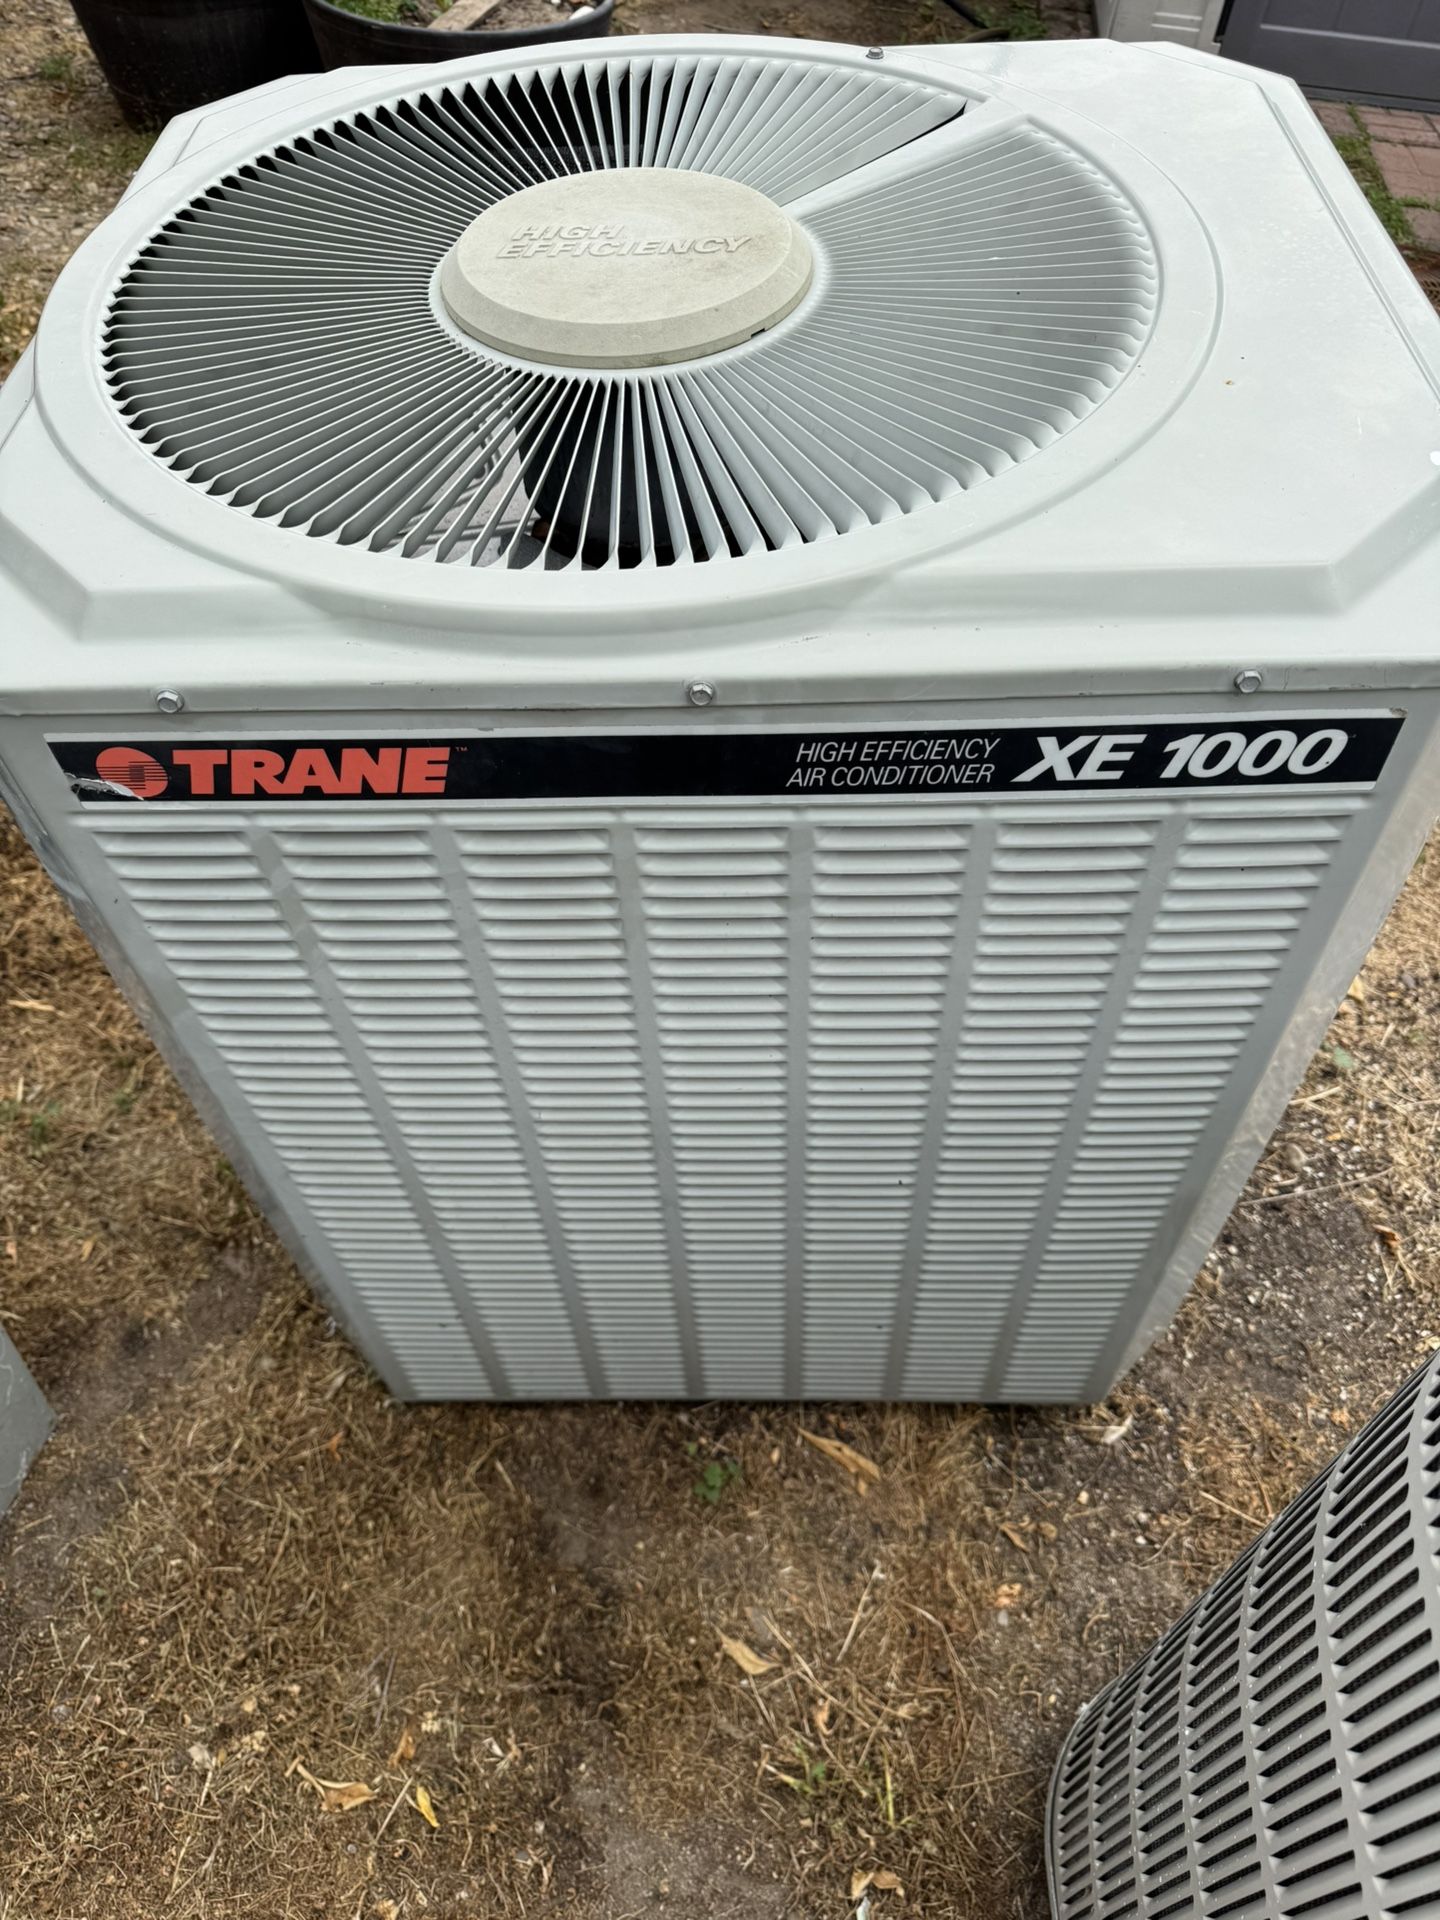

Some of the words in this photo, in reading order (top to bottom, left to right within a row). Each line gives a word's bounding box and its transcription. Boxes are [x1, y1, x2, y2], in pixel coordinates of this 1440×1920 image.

[511, 224, 625, 242] HIGH
[496, 236, 753, 259] EFFICIENCY
[796, 742, 857, 763] HIGH
[860, 738, 1000, 761] EFFICIENCY
[1010, 734, 1146, 783] XE
[1160, 729, 1348, 779] 1000
[173, 747, 450, 794] TRANE
[787, 767, 826, 787] AIR
[830, 764, 996, 786] CONDITIONER
